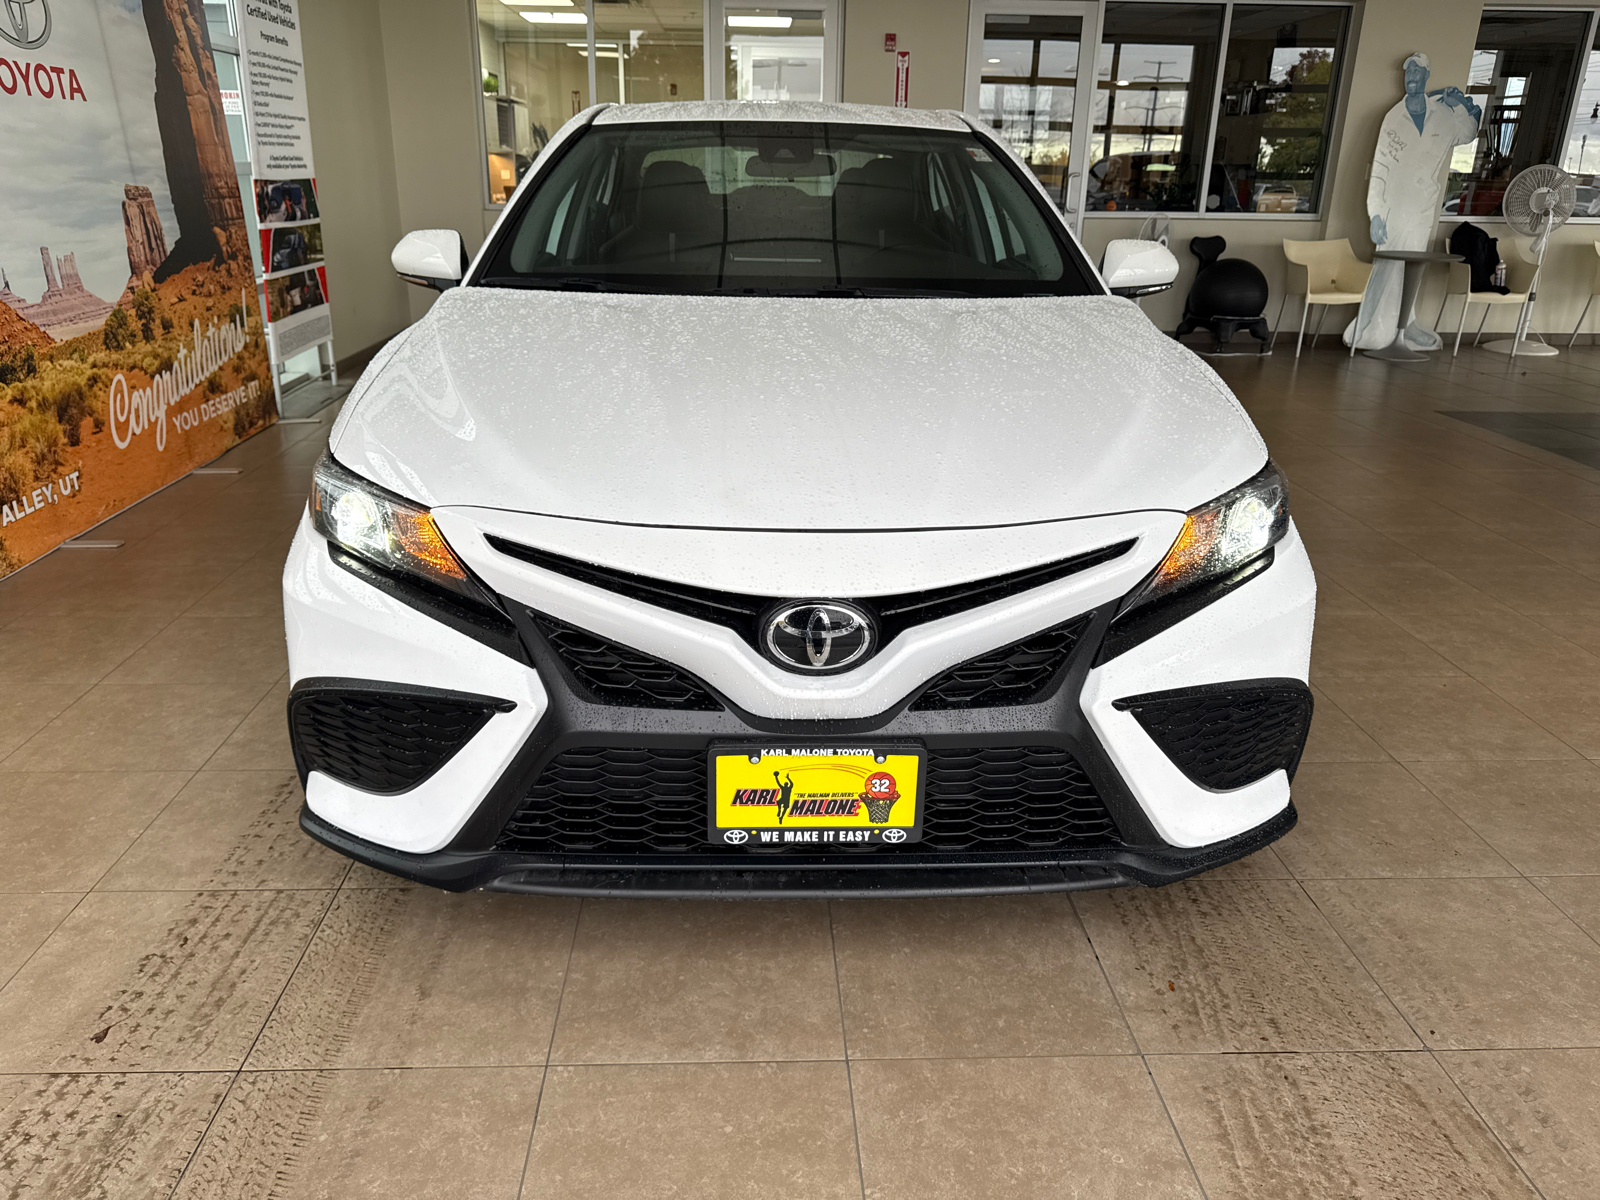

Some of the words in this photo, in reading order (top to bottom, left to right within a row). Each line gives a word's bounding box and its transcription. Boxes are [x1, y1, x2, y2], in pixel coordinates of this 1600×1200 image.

[246, 4, 267, 20] Certified
[267, 11, 279, 24] Used
[279, 15, 296, 30] Vehicles
[0, 57, 88, 102] OYOTA
[109, 287, 250, 452] Congratulations!
[172, 410, 199, 434] YOU
[200, 386, 247, 421] DESERVE
[247, 379, 261, 400] IT!
[2, 483, 59, 528] ALLEY,
[58, 471, 80, 496] UT
[760, 748, 789, 757] KARL
[791, 748, 834, 757] MALONE
[835, 748, 875, 757] TOYOTA
[871, 778, 890, 793] 32
[730, 788, 781, 807] KARL
[787, 798, 862, 818] MALONE
[760, 831, 780, 842] WE
[784, 831, 819, 842] MAKE
[823, 831, 835, 842] IT
[839, 830, 871, 842] EASY
